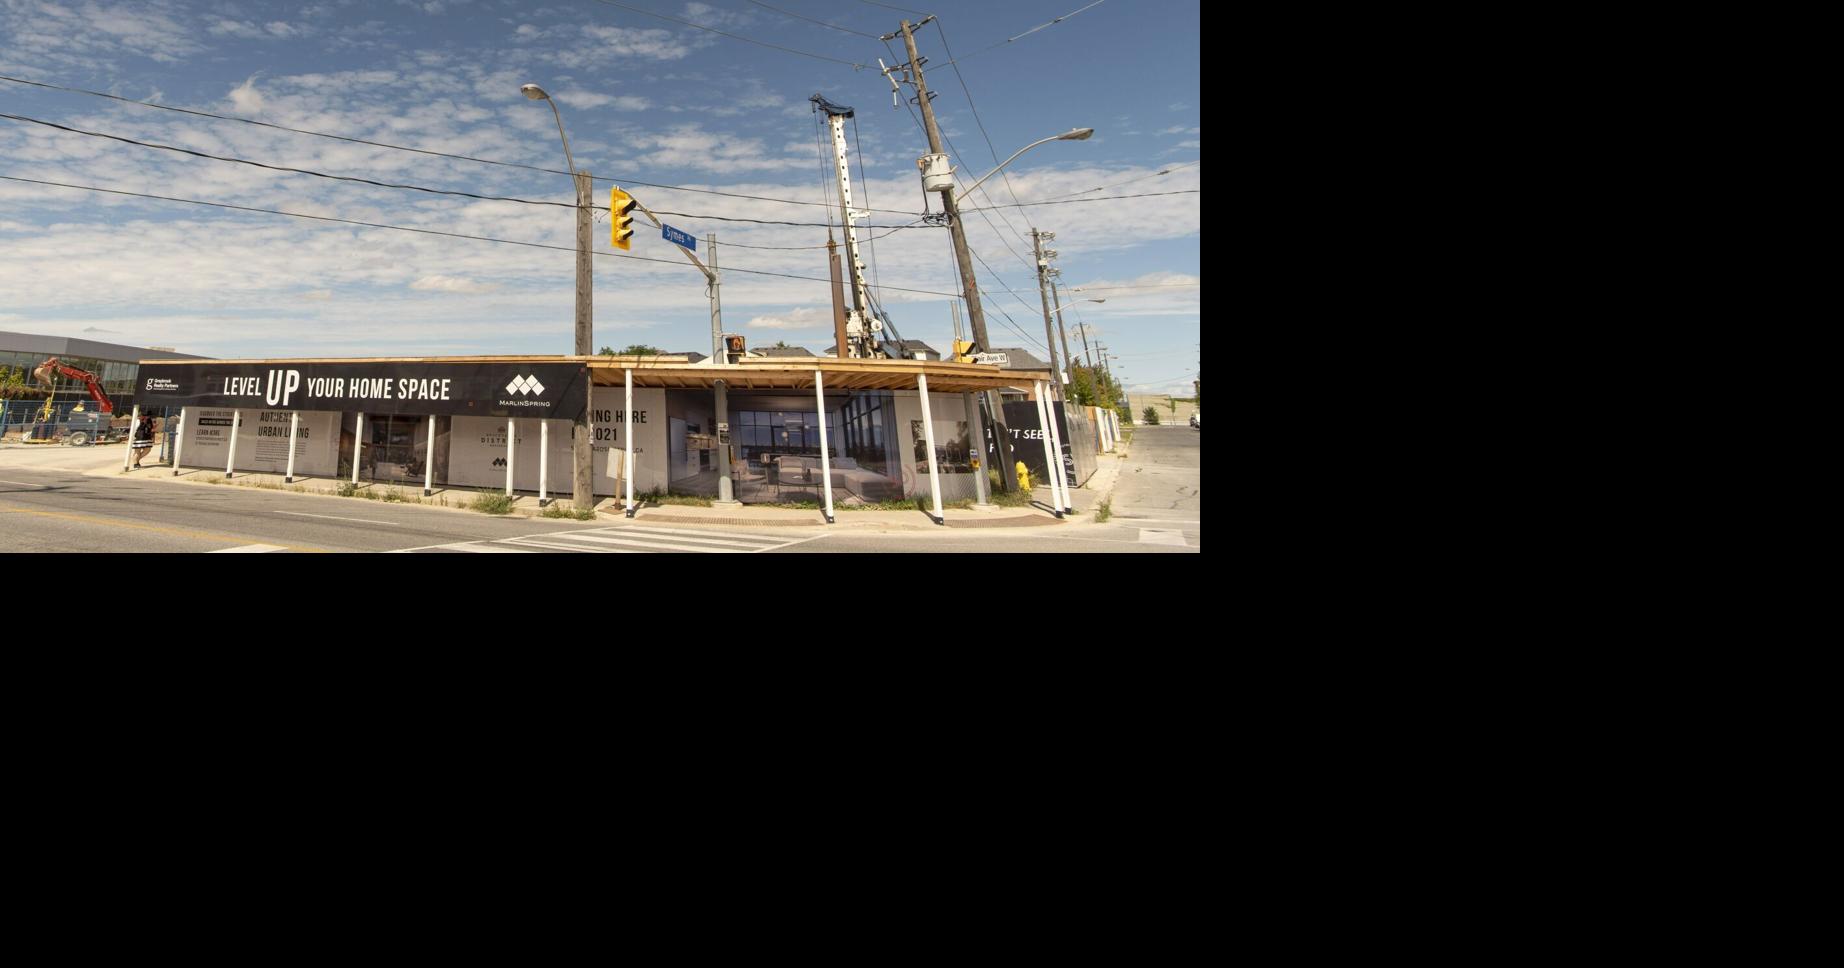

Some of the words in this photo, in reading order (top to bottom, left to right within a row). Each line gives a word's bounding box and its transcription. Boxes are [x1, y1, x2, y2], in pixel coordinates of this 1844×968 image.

[223, 377, 262, 396] LEVEL
[266, 369, 300, 406] UP
[307, 377, 344, 398] YOUR
[349, 378, 393, 399] HOME
[397, 378, 451, 400] SPACE
[258, 426, 283, 438] URBAN
[284, 427, 310, 439] LIING
